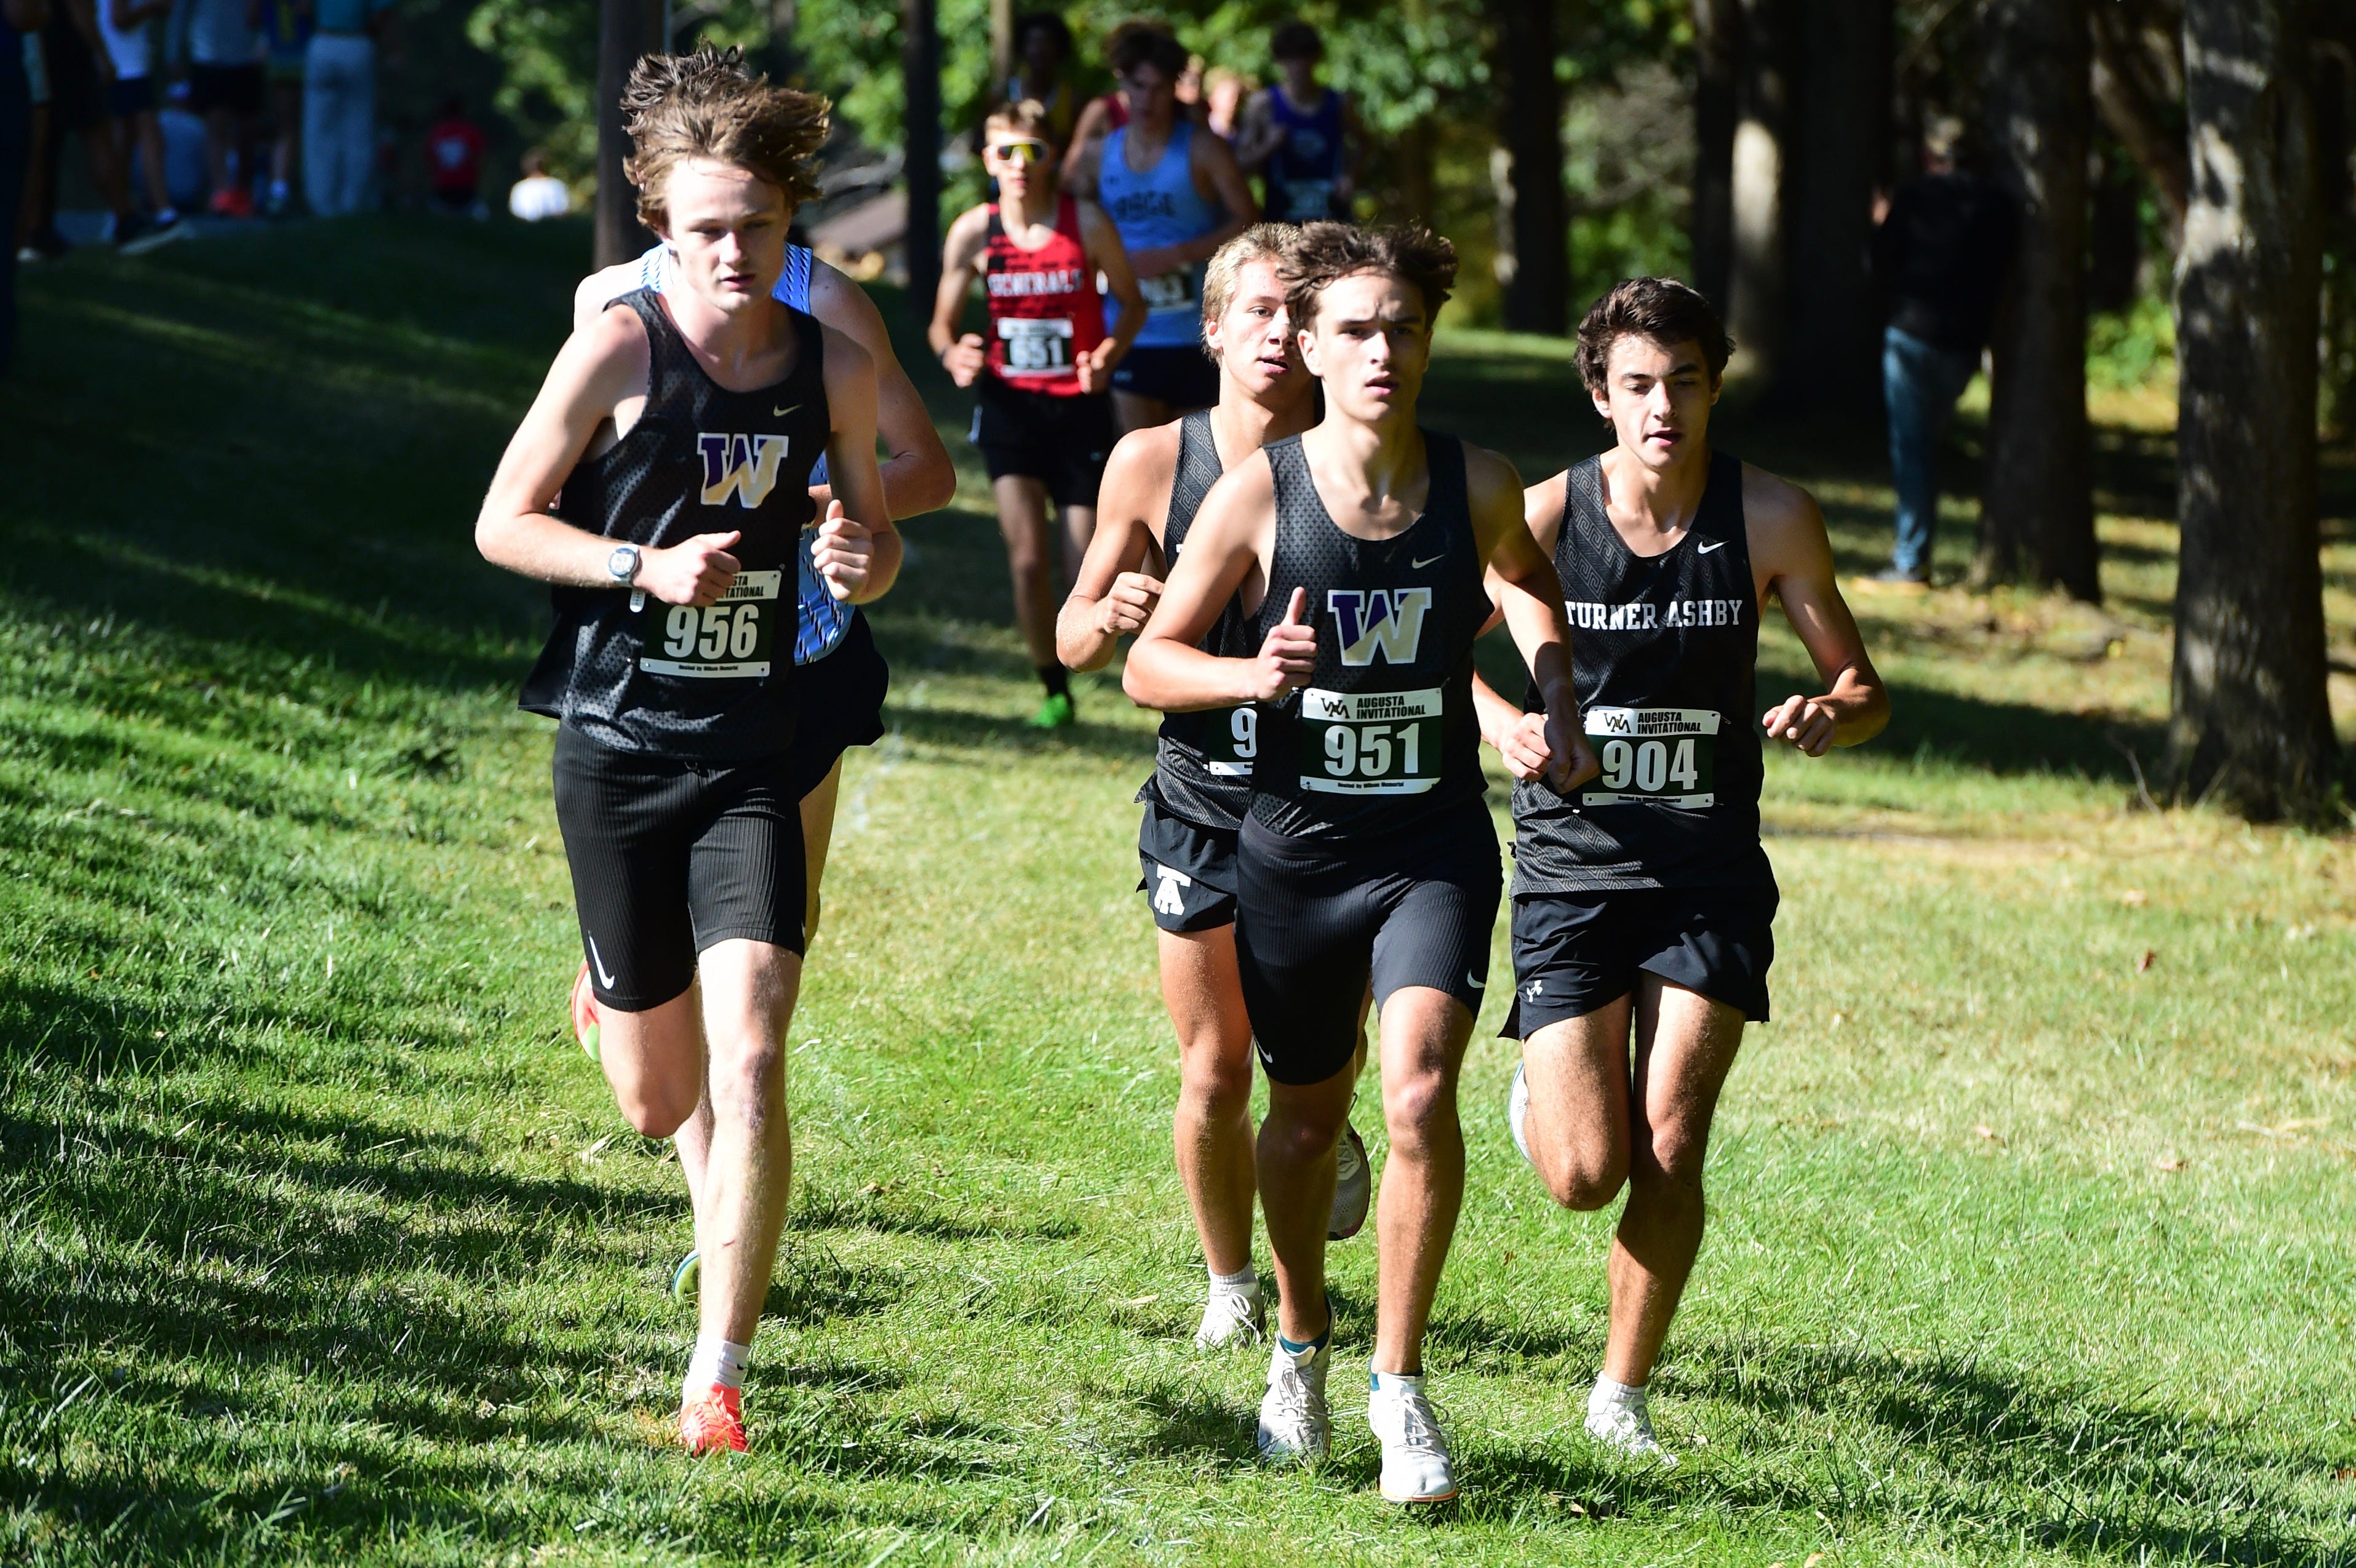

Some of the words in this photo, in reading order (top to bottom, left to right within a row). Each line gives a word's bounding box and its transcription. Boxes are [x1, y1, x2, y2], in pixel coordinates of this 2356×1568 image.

[697, 432, 789, 509] W
[664, 603, 759, 659] 956
[1327, 587, 1432, 666] W
[1565, 600, 1658, 631] TURNER
[1666, 600, 1743, 627] ASHBY
[1356, 696, 1405, 708] AUGUSTA
[1356, 705, 1426, 719] INVITATIONAL
[1637, 712, 1682, 723] AUGUSTA
[1637, 722, 1701, 734] INVITATIONAL
[1324, 723, 1420, 776] 951
[1602, 739, 1698, 792] 904
